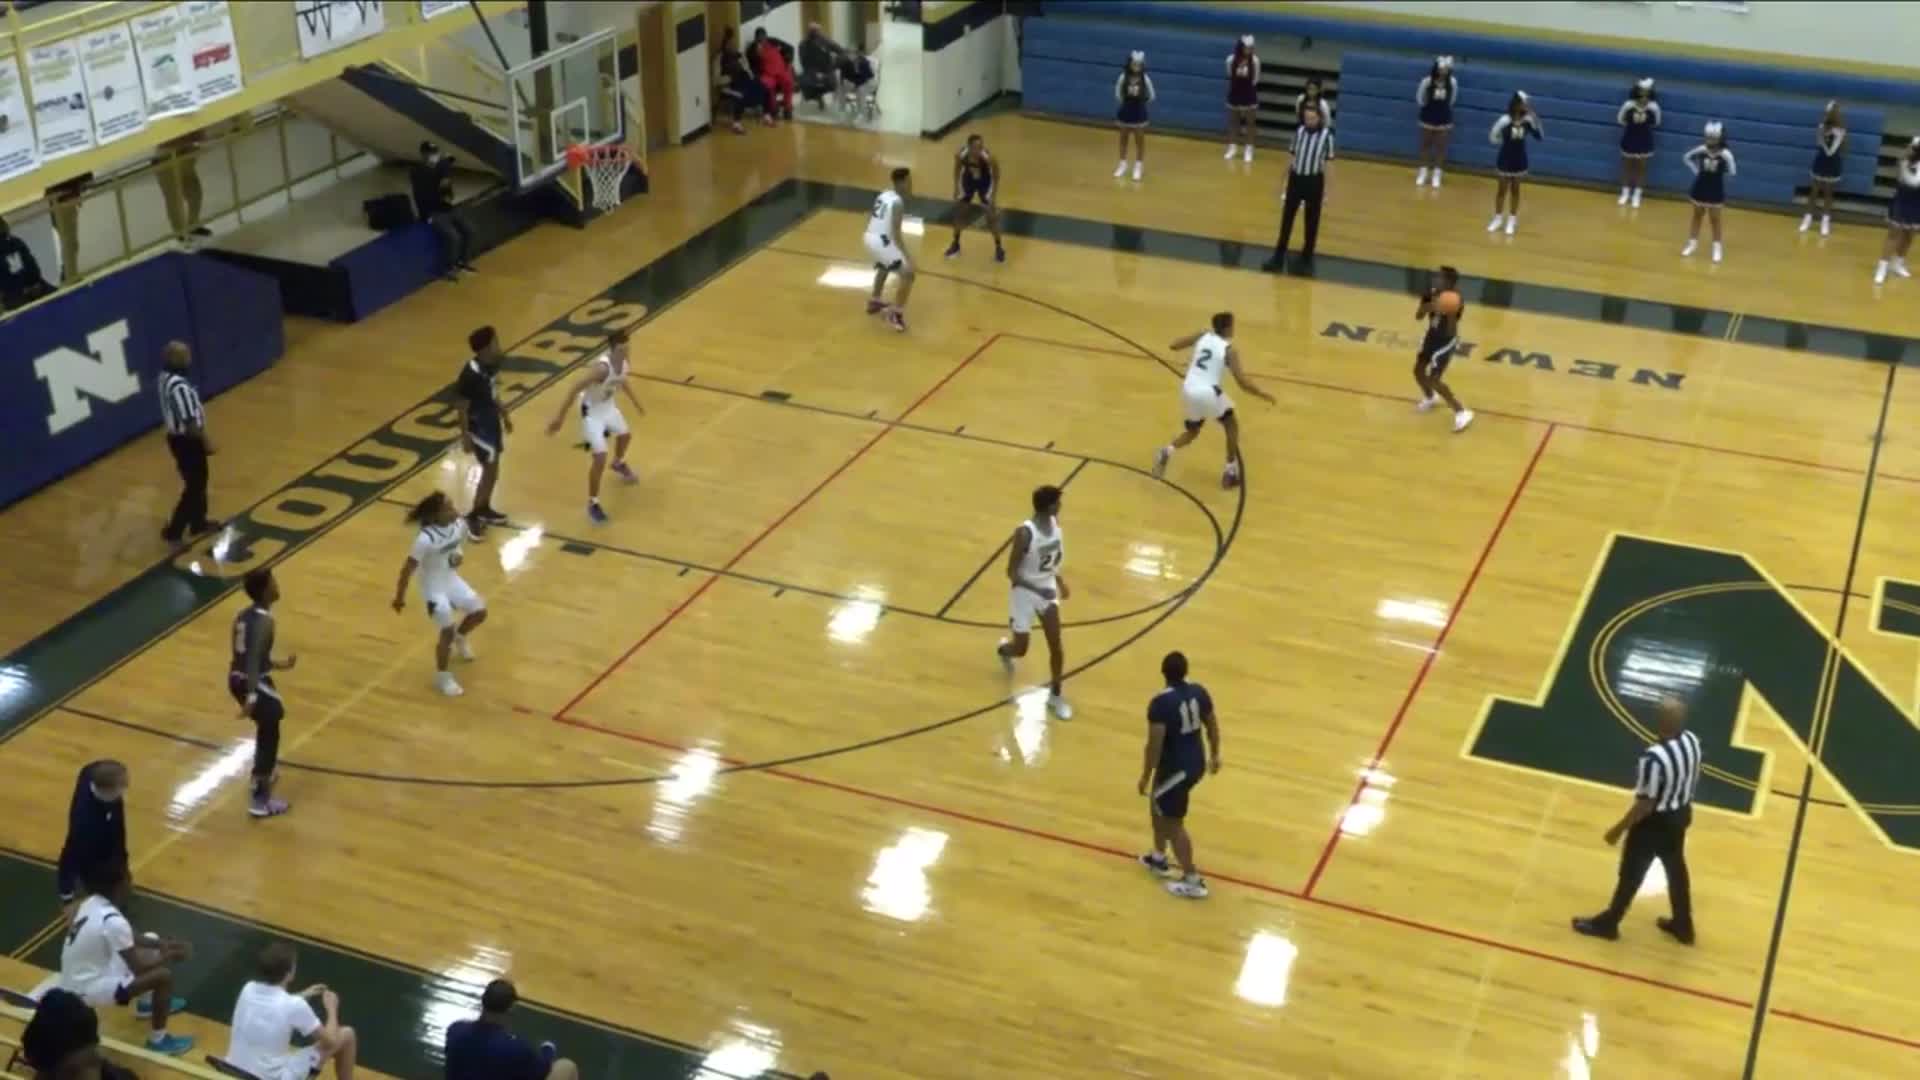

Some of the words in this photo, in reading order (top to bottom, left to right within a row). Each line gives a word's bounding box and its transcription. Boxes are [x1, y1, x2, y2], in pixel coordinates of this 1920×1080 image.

[33, 318, 141, 435] N
[1195, 348, 1213, 371] 2
[1179, 697, 1201, 735] 11
